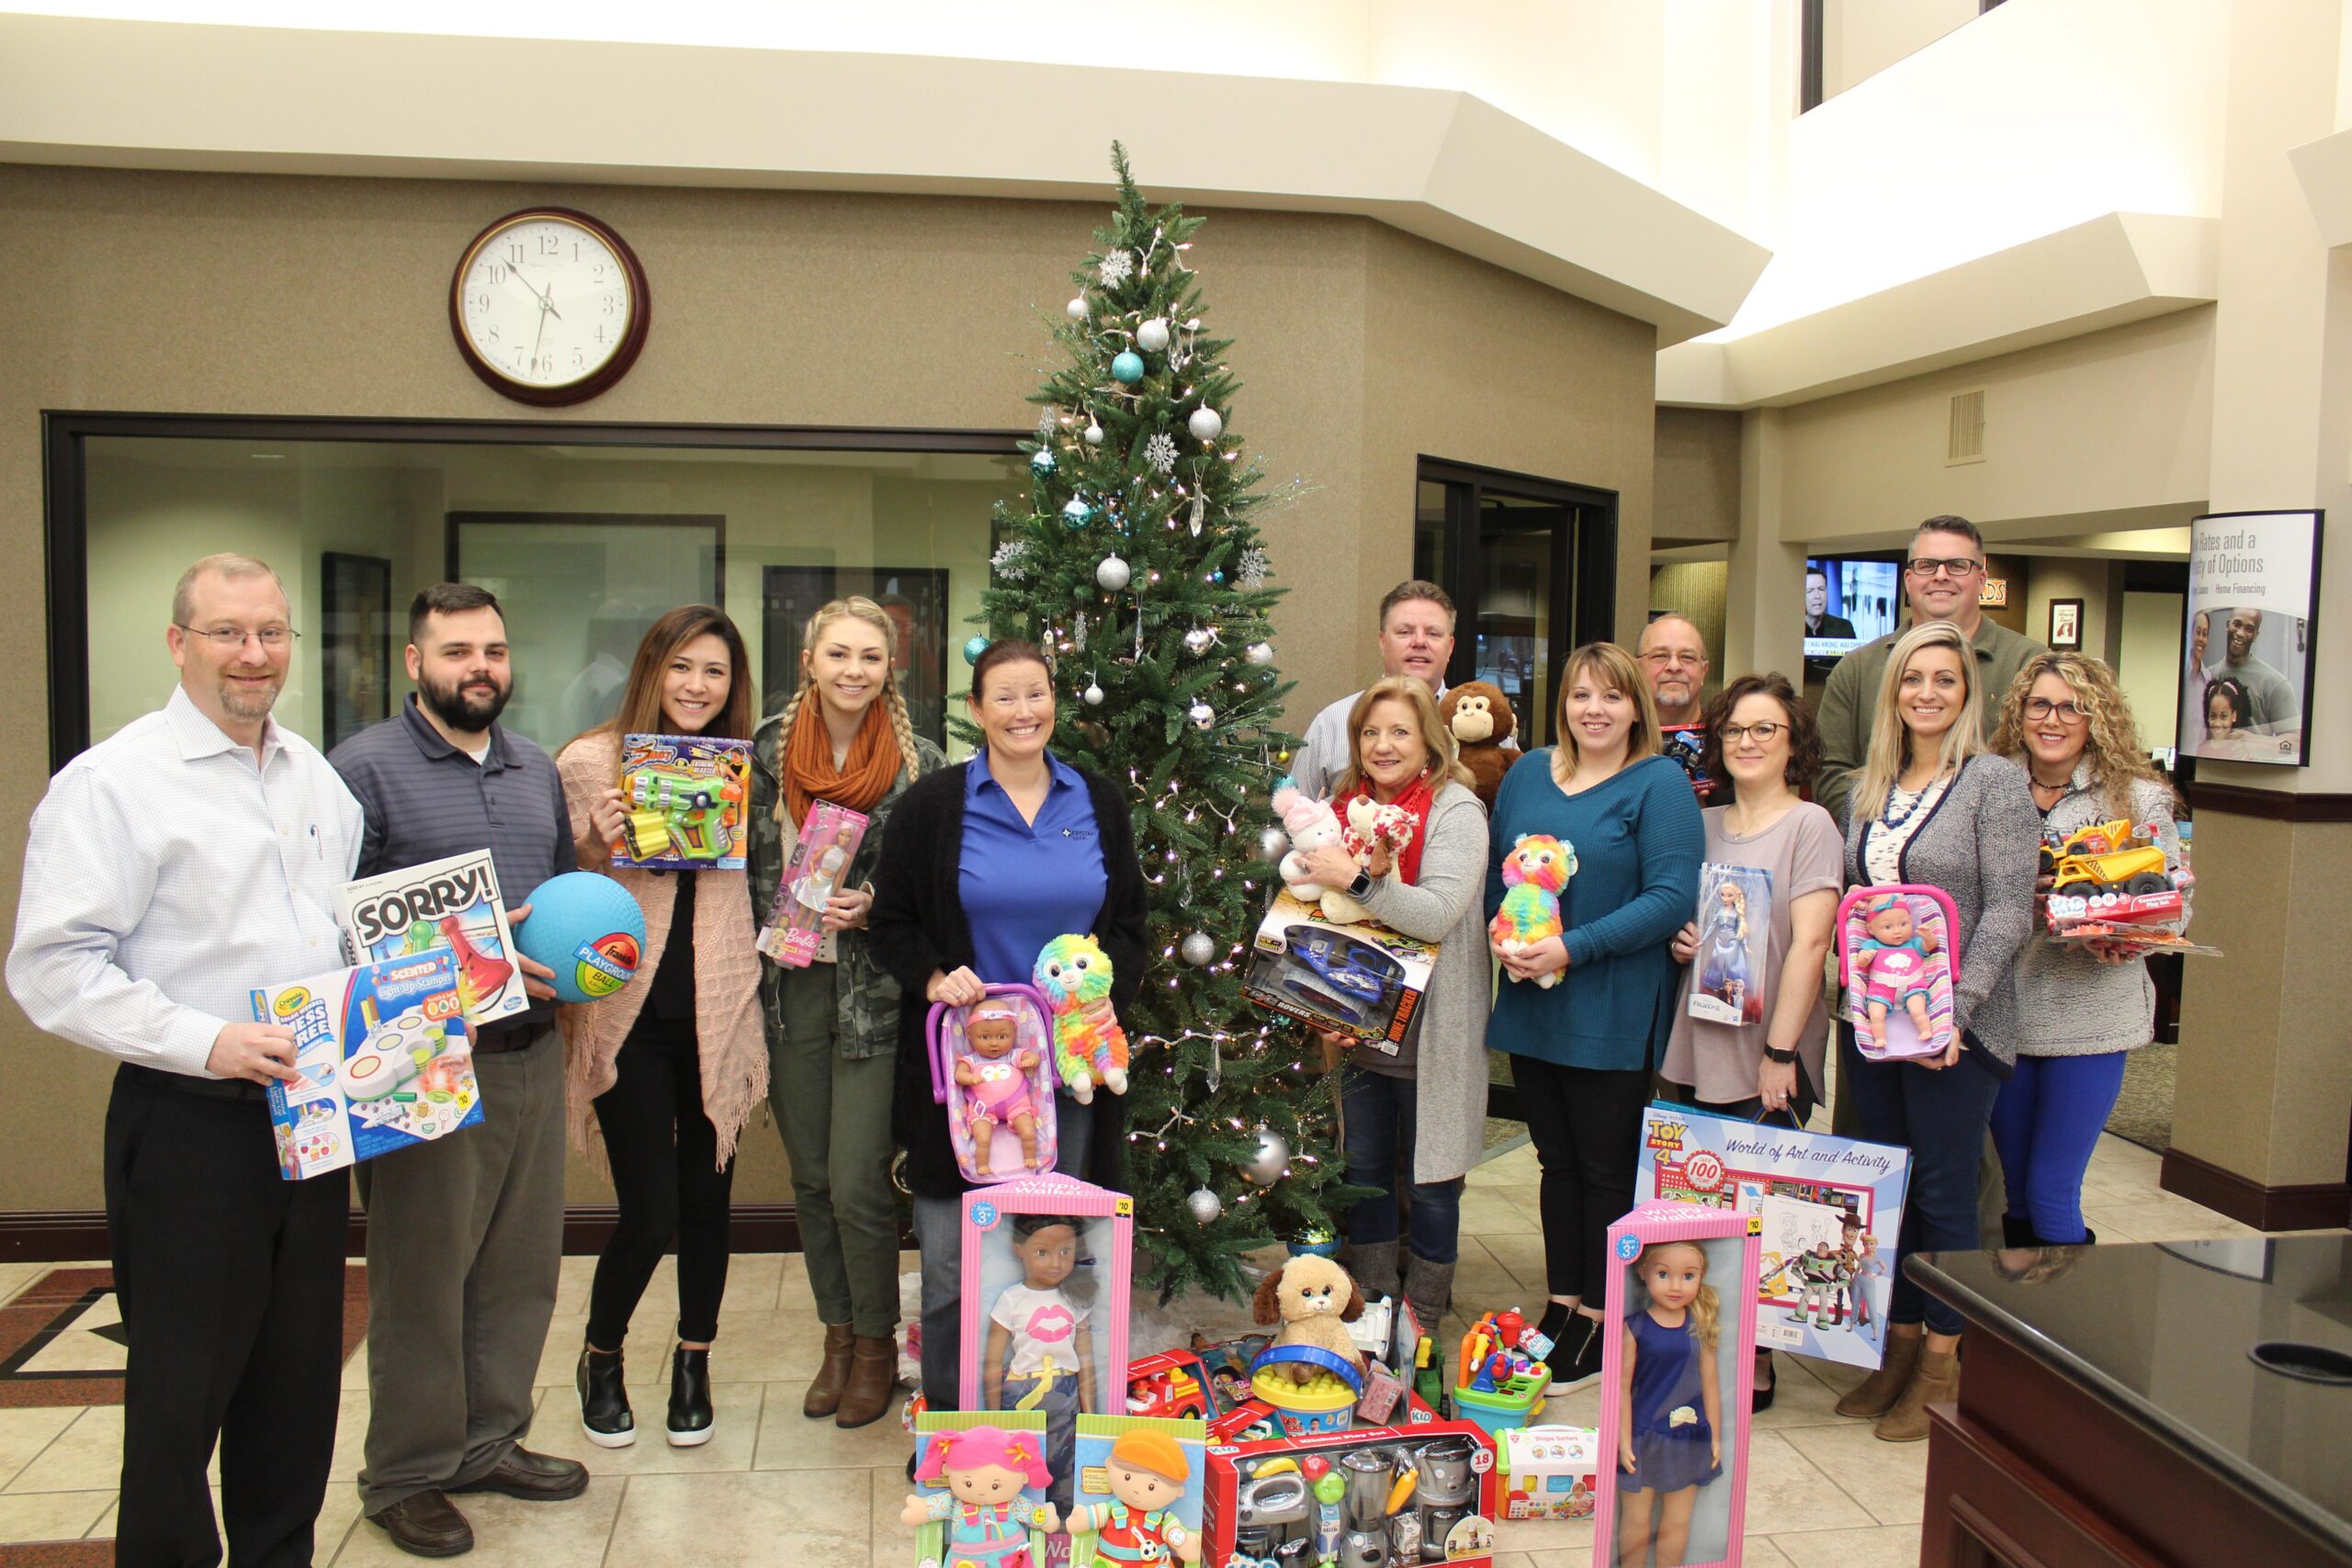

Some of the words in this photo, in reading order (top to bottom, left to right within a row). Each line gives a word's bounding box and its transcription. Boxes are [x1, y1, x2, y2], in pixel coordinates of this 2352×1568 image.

[509, 243, 524, 264] 11
[538, 235, 559, 255] 12
[572, 243, 580, 262] 1
[488, 265, 506, 285] 10
[594, 265, 604, 283] 2
[479, 294, 490, 313] 9
[604, 295, 614, 315] 3
[488, 324, 500, 344] 8
[594, 324, 605, 344] 4
[514, 346, 524, 367] 7
[541, 353, 552, 373] 6
[572, 347, 582, 367] 5
[2199, 532, 2221, 551] Rates
[2223, 529, 2244, 549] and
[2248, 534, 2256, 549] a
[2208, 554, 2216, 573] of
[2219, 553, 2264, 578] Options
[2215, 583, 2231, 593] Home
[2233, 582, 2266, 596] Financing
[357, 865, 492, 942] SORRY!
[2138, 894, 2177, 905] Construction
[785, 927, 817, 948] Barbie
[390, 962, 437, 980] SCENTED
[593, 972, 615, 987] BALL
[379, 982, 415, 998] Light-Up
[418, 974, 451, 989] Stamper
[278, 992, 303, 1007] Crayola
[280, 1010, 300, 1023] COLOR
[1276, 1000, 1312, 1019] ROVERS
[1387, 1018, 1406, 1043] DUNE
[1397, 988, 1419, 1020] TRACKER
[294, 1019, 331, 1049] REE
[1648, 1120, 1689, 1141] TOY
[1650, 1138, 1680, 1149] STORY
[1655, 1148, 1671, 1167] 4
[1726, 1139, 1766, 1156] World
[1769, 1145, 1783, 1162] of
[1786, 1145, 1810, 1159] Art
[1811, 1150, 1840, 1163] and
[1841, 1150, 1891, 1175] Activity
[1690, 1161, 1718, 1179] 100
[1019, 1180, 1081, 1190] Wispy
[978, 1212, 991, 1224] 3+
[1642, 1206, 1702, 1216] Wispy
[1647, 1212, 1714, 1223] Walker
[1623, 1244, 1635, 1258] 3+
[1528, 1335, 1542, 1349] KID
[1411, 1410, 1431, 1422] KID
[1298, 1435, 1343, 1444] Kitchen
[1343, 1432, 1367, 1441] Play
[1368, 1429, 1388, 1438] Set
[1211, 1446, 1238, 1454] KID
[1475, 1454, 1489, 1465] 18
